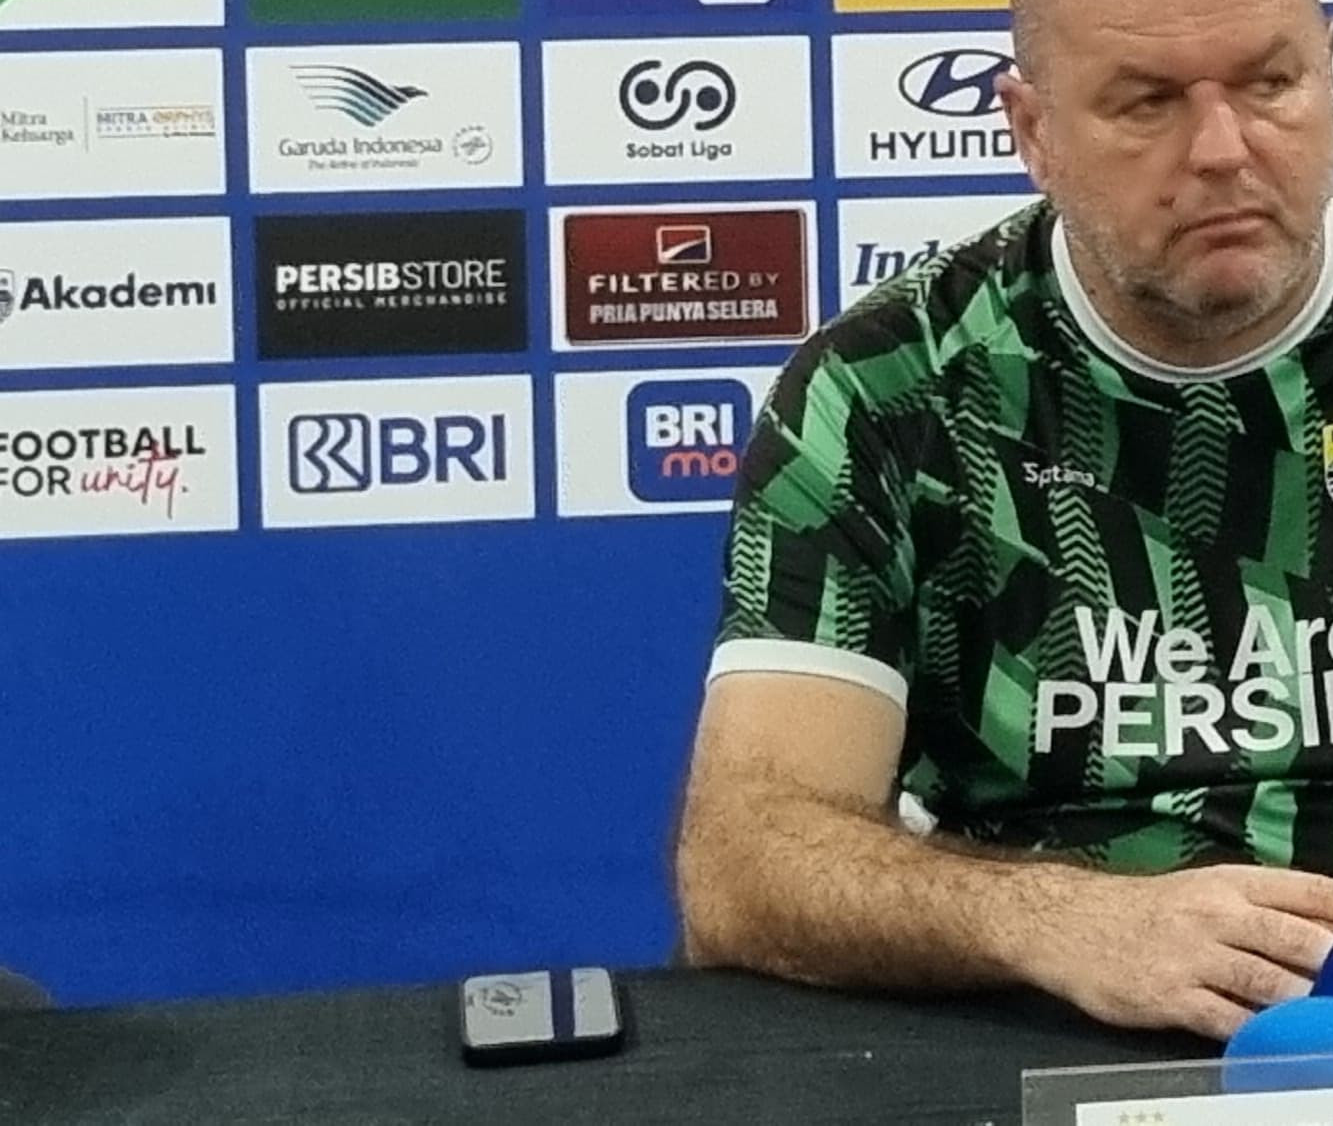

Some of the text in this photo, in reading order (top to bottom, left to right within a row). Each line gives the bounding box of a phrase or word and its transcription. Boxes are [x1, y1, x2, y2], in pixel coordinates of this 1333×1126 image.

[280, 137, 442, 157] Garuda Indonesia
[627, 141, 732, 160] Sobat Liga
[870, 129, 1015, 160] HYUND
[20, 273, 216, 310] Akademi
[589, 273, 779, 293] FILTERED BY
[276, 292, 506, 310] OFFICIAL MERCHANDISE
[589, 299, 778, 323] PRIA PUNYA SELERA
[646, 404, 732, 449] BRI
[382, 414, 505, 485] BRI
[663, 449, 737, 478] mo
[1074, 605, 1204, 683] We
